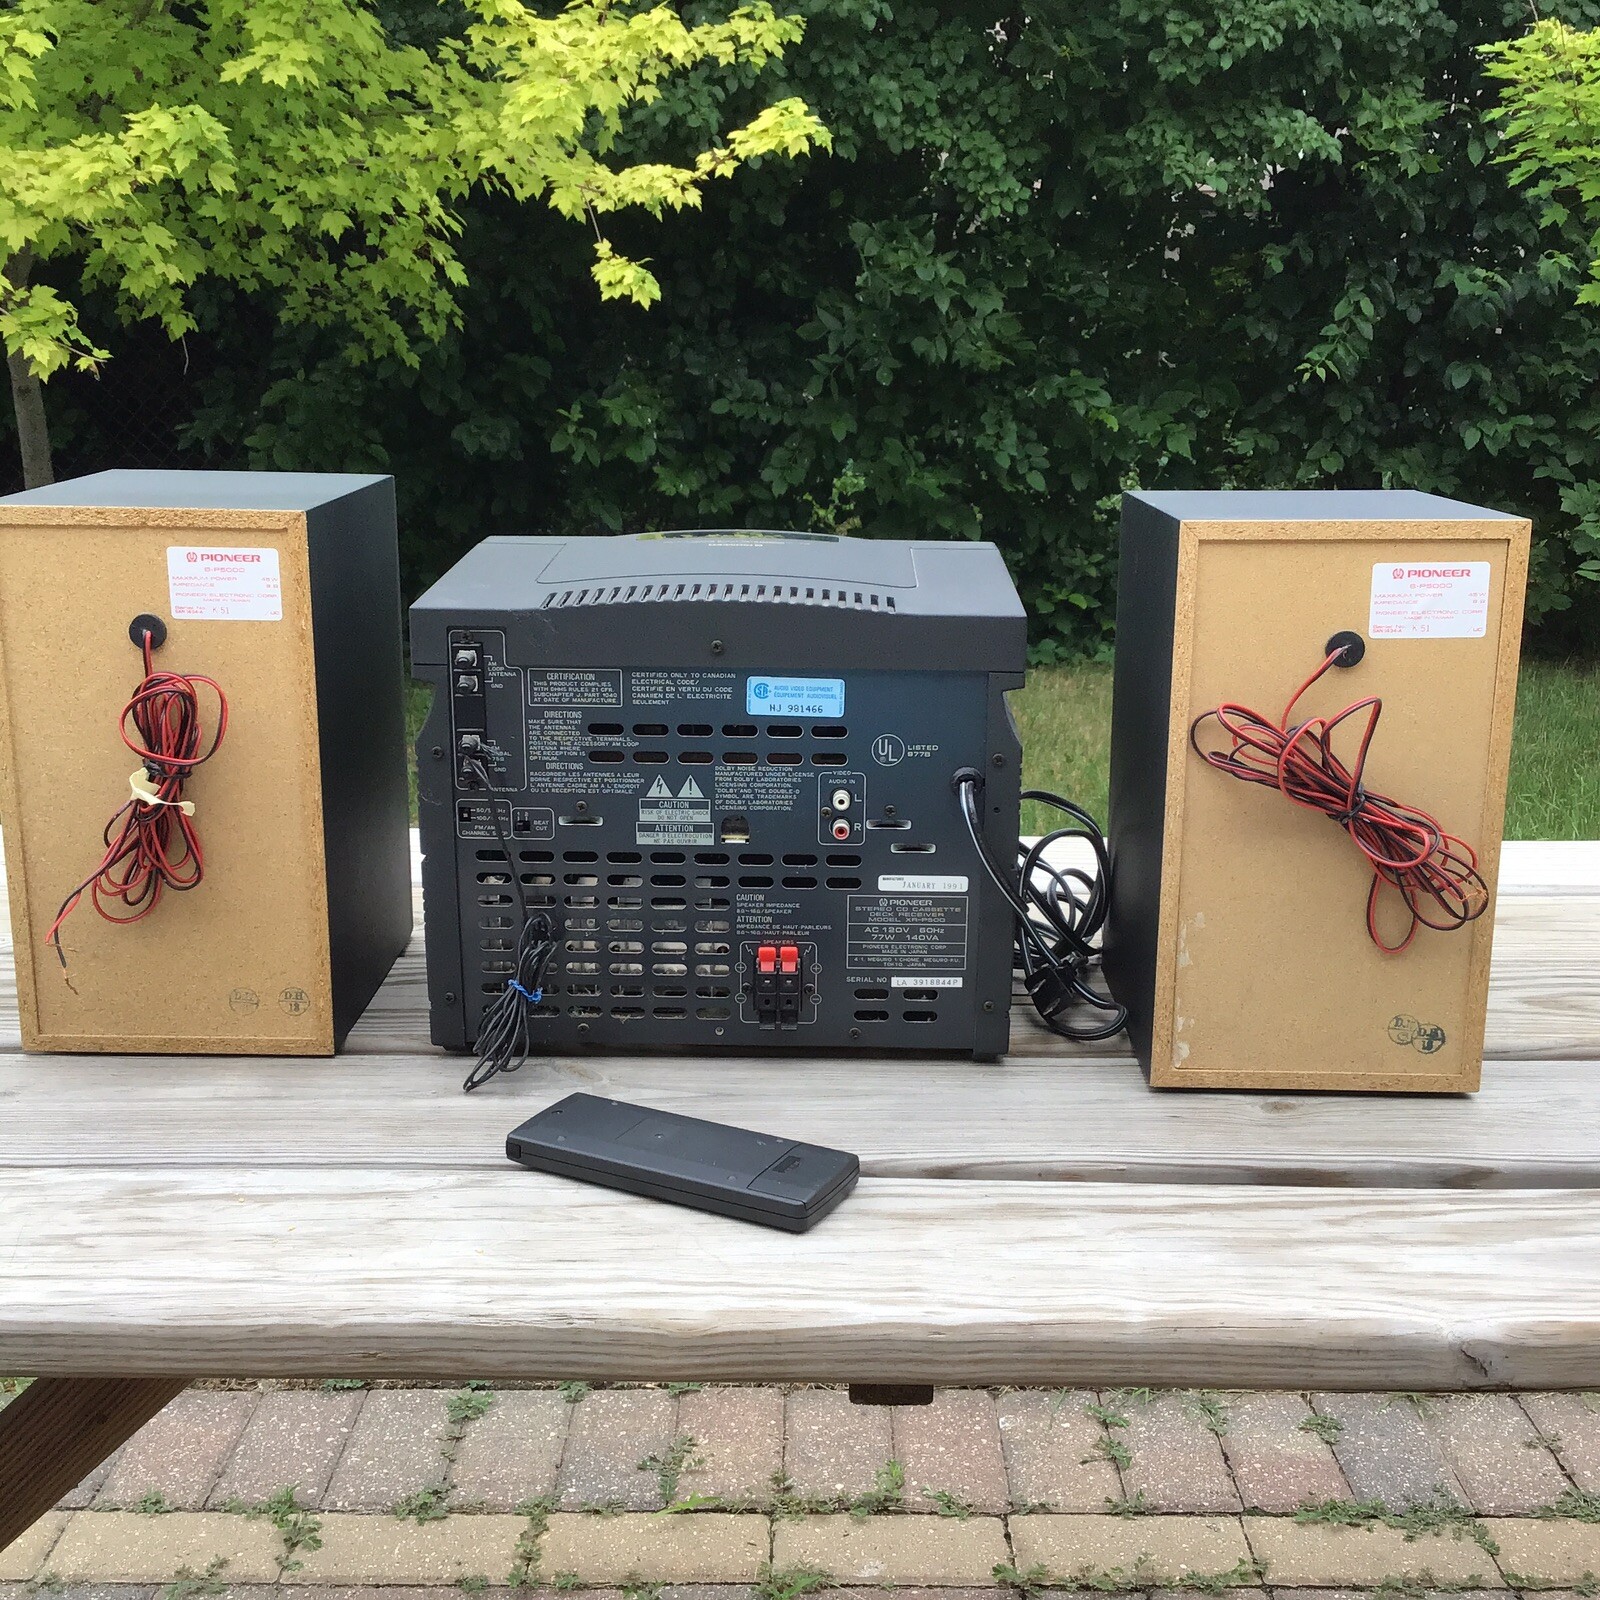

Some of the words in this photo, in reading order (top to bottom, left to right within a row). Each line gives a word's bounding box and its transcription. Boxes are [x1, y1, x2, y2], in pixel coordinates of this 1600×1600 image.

[201, 554, 261, 562] PIONEER
[1408, 569, 1471, 577] PIONEER
[787, 704, 823, 713] 981466
[879, 739, 897, 762] UL
[854, 794, 862, 802] L
